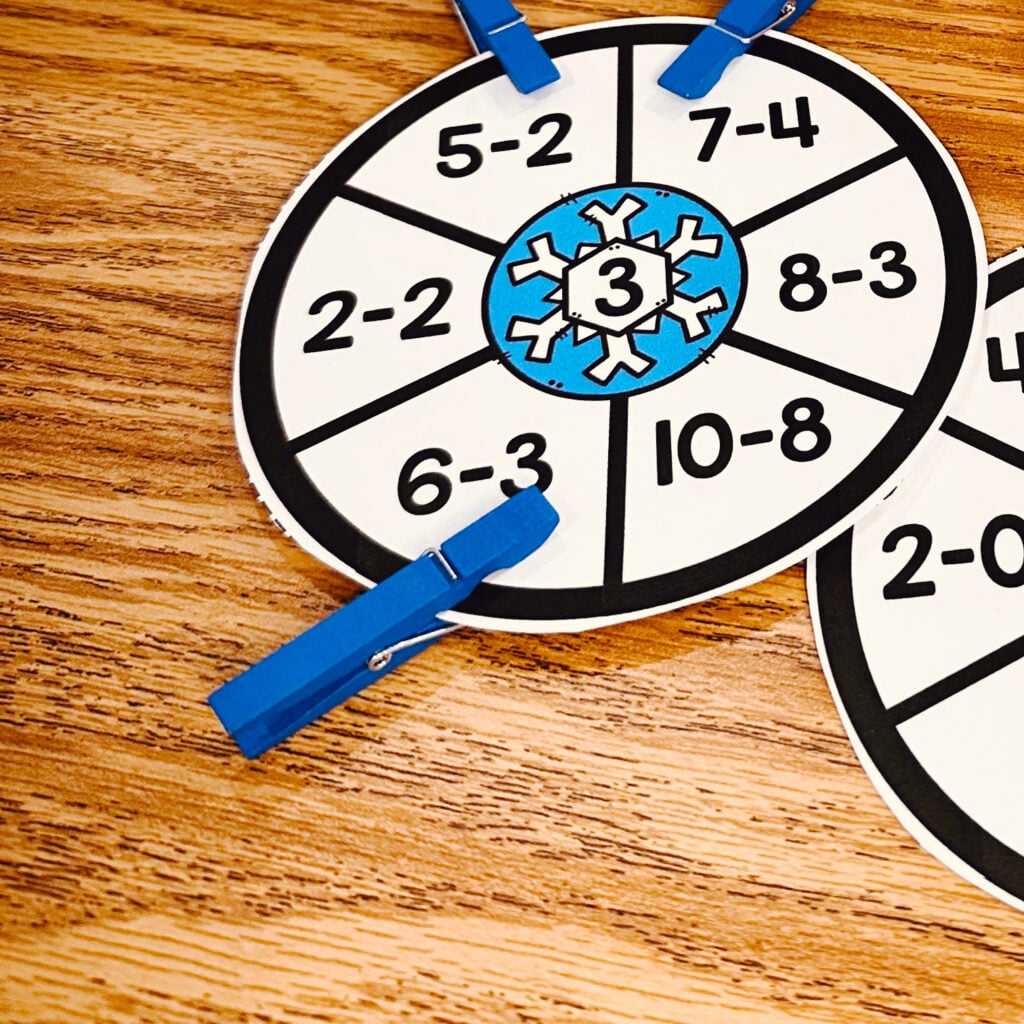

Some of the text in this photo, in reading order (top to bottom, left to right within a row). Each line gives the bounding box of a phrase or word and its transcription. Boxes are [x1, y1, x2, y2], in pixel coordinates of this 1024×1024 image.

[437, 112, 573, 178] 5-2
[689, 96, 819, 162] 7-4
[594, 258, 644, 317] 3
[780, 241, 916, 312] 8-3
[303, 278, 452, 353] 2-2
[398, 433, 553, 516] 6-3
[656, 398, 831, 485] 10-8
